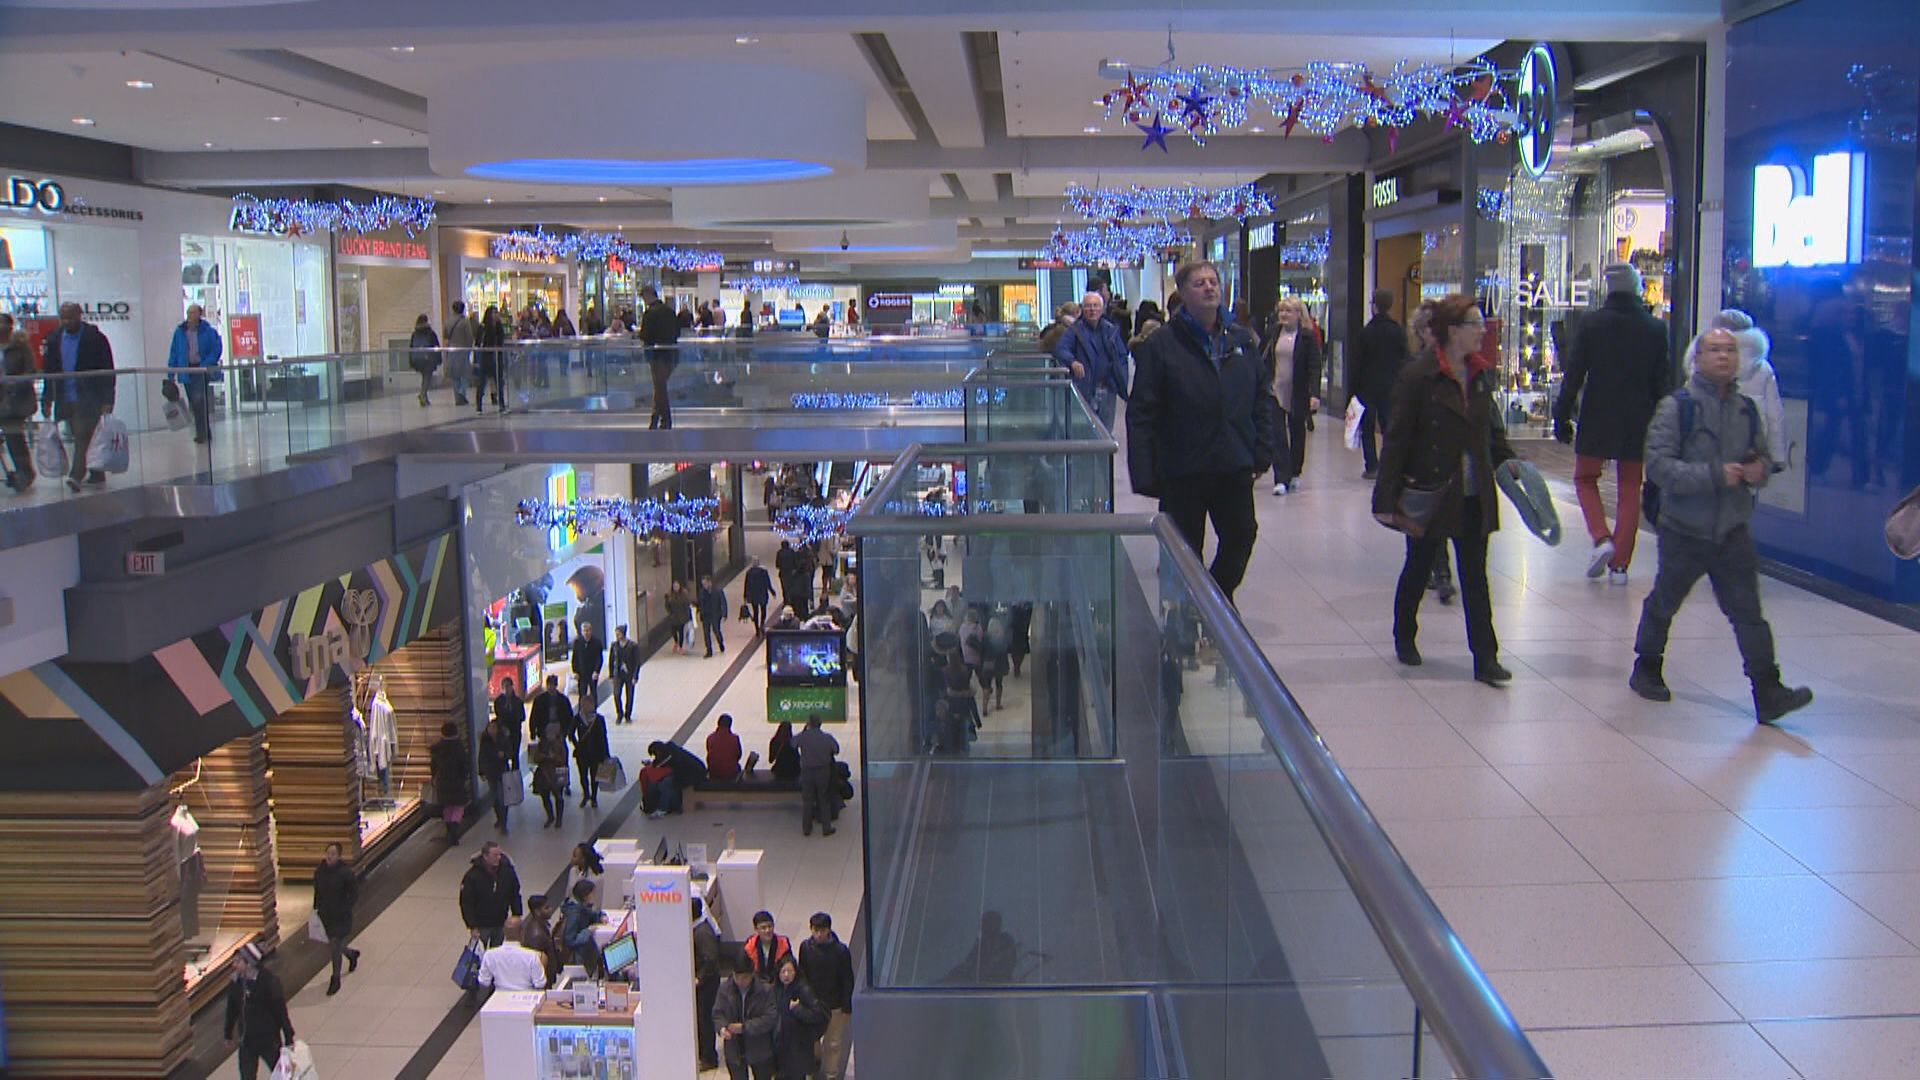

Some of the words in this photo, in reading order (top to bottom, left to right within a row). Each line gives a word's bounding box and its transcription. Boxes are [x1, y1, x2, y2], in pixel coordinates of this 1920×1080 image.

[1373, 177, 1398, 208] FOSSIL
[63, 205, 143, 220] ACCESSORIES
[340, 236, 370, 256] LUCKY
[373, 239, 401, 258] BRAND
[404, 241, 427, 260] JEANS
[880, 297, 911, 307] ROGERS
[1516, 279, 1590, 308] SALE
[80, 302, 130, 315] LDO
[133, 554, 154, 572] EXIT
[288, 630, 351, 682] tna
[640, 890, 682, 904] WIND
